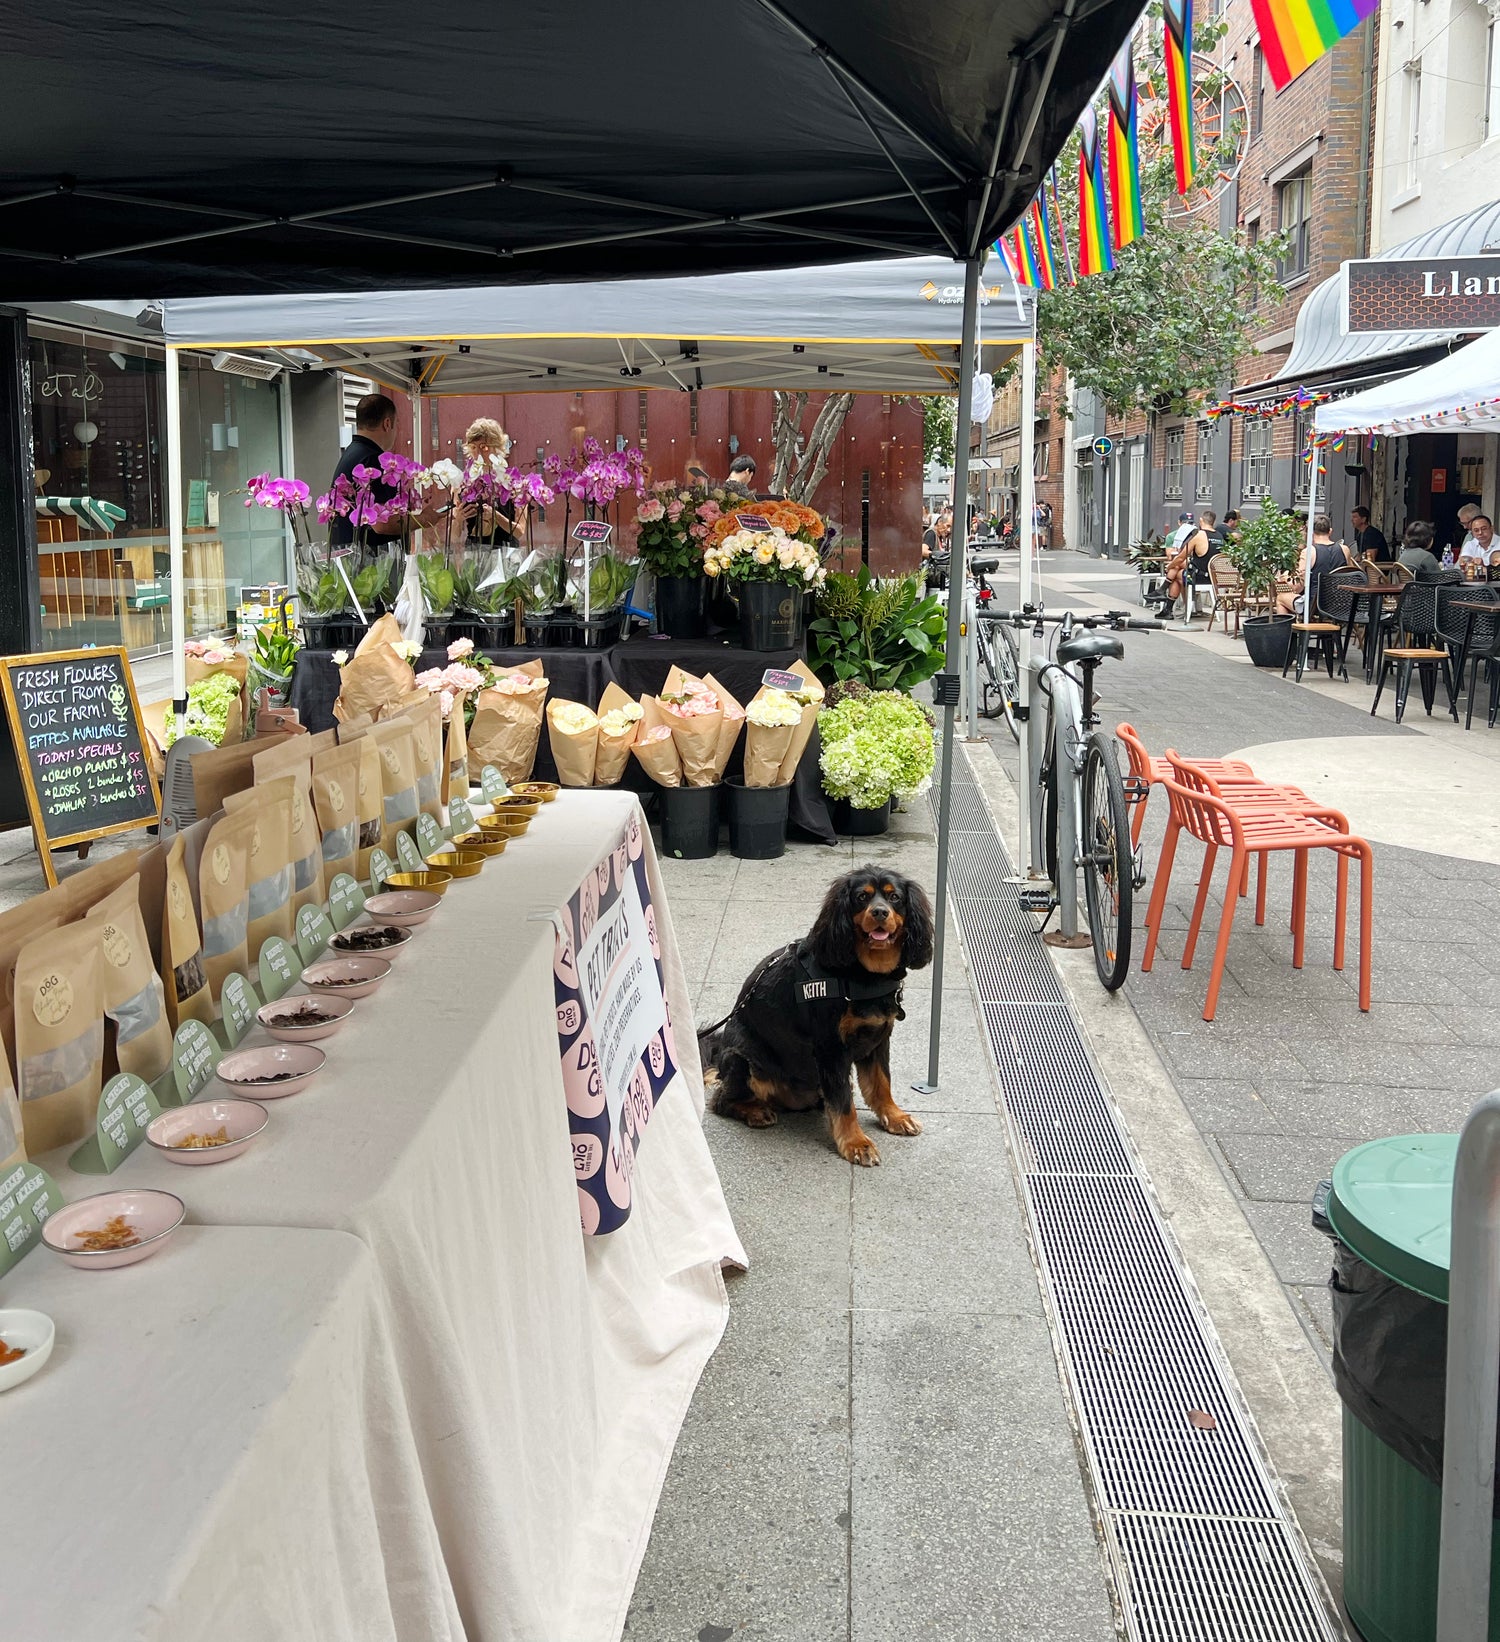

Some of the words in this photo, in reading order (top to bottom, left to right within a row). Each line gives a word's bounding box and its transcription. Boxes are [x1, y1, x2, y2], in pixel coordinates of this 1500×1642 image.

[17, 669, 59, 689] FRESH
[64, 664, 118, 685] FLOWERS
[21, 689, 67, 710] DIRECT
[71, 685, 108, 703] FROM
[29, 709, 59, 728] OUR
[63, 702, 107, 723] FARM!
[29, 731, 70, 749] EFTPOS
[72, 723, 128, 741] AVAILABLE
[76, 742, 122, 760] SPECIALS
[84, 758, 118, 774] PLANTS
[87, 778, 95, 789] 2
[90, 794, 99, 807] 3
[39, 975, 59, 997] DOG
[587, 943, 602, 1011] PET
[803, 981, 827, 999] KEITH
[0, 1168, 25, 1198] URKEY
